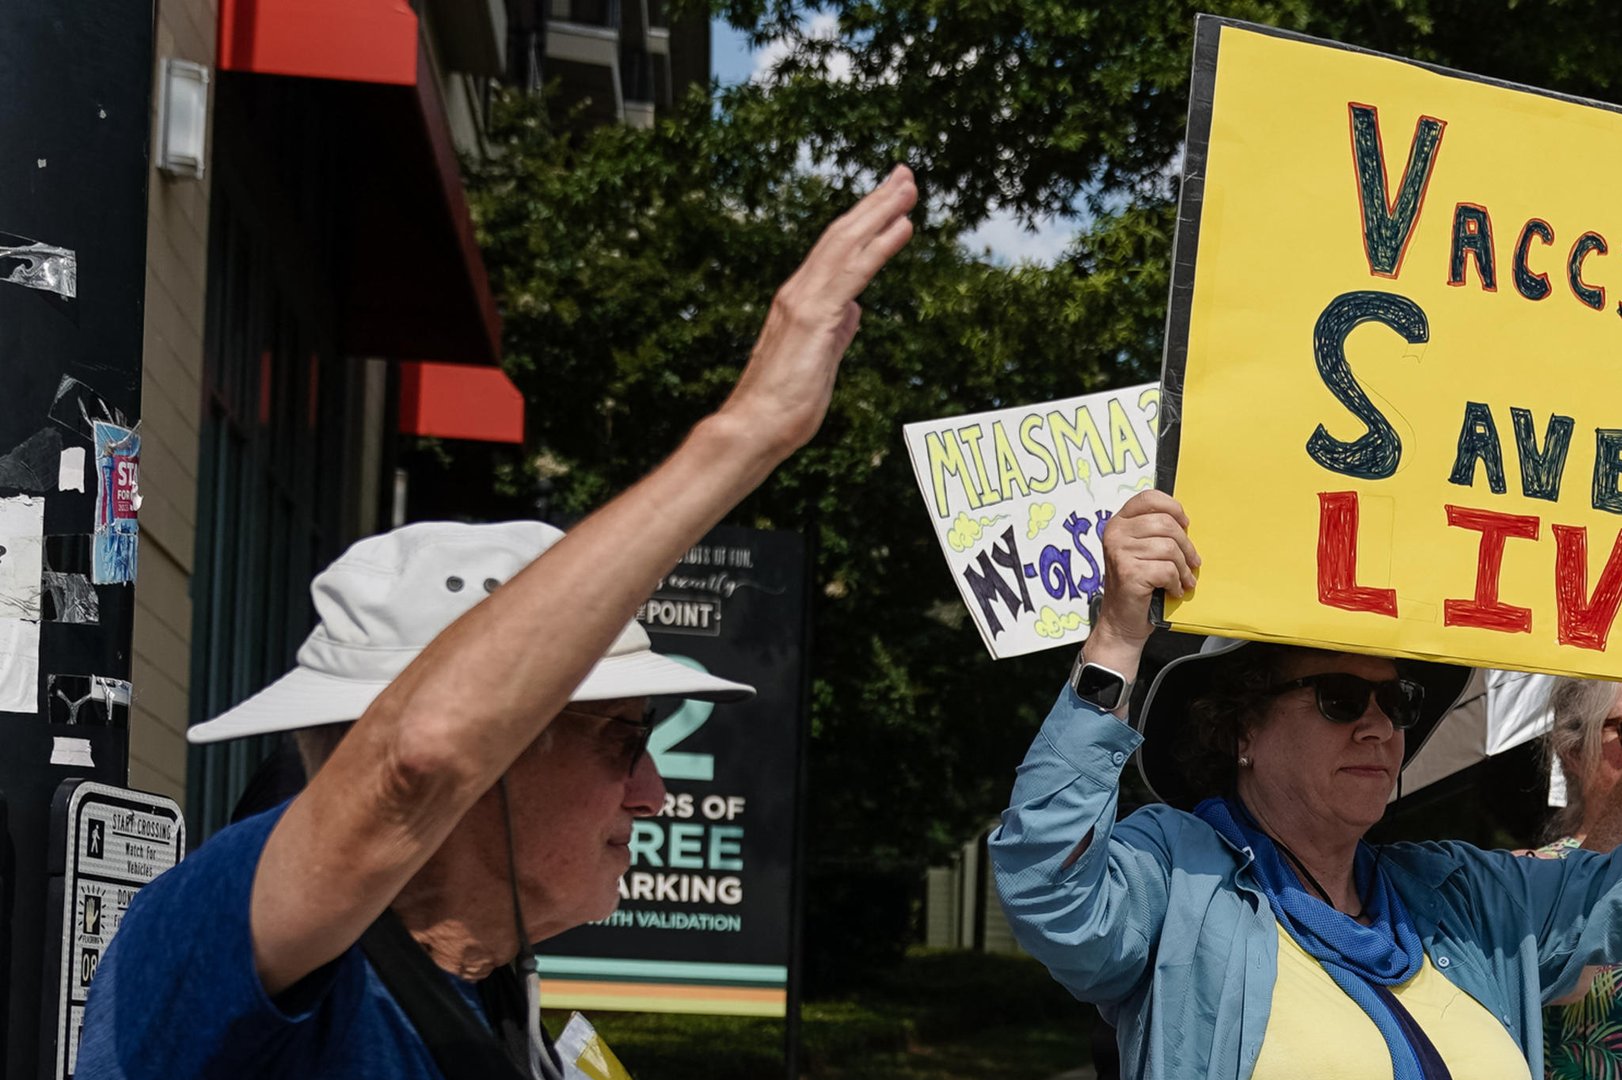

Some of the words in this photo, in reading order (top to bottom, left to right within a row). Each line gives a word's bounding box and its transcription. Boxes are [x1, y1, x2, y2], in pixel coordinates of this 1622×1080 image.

[646, 600, 714, 628] POINT
[702, 795, 746, 820] OF
[137, 819, 171, 840] CROSSING
[126, 843, 143, 858] Watch
[146, 846, 157, 860] For
[627, 820, 745, 871] REE
[127, 861, 153, 877] Vehicles
[617, 872, 742, 905] ARKING
[635, 910, 741, 932] VALIDATION
